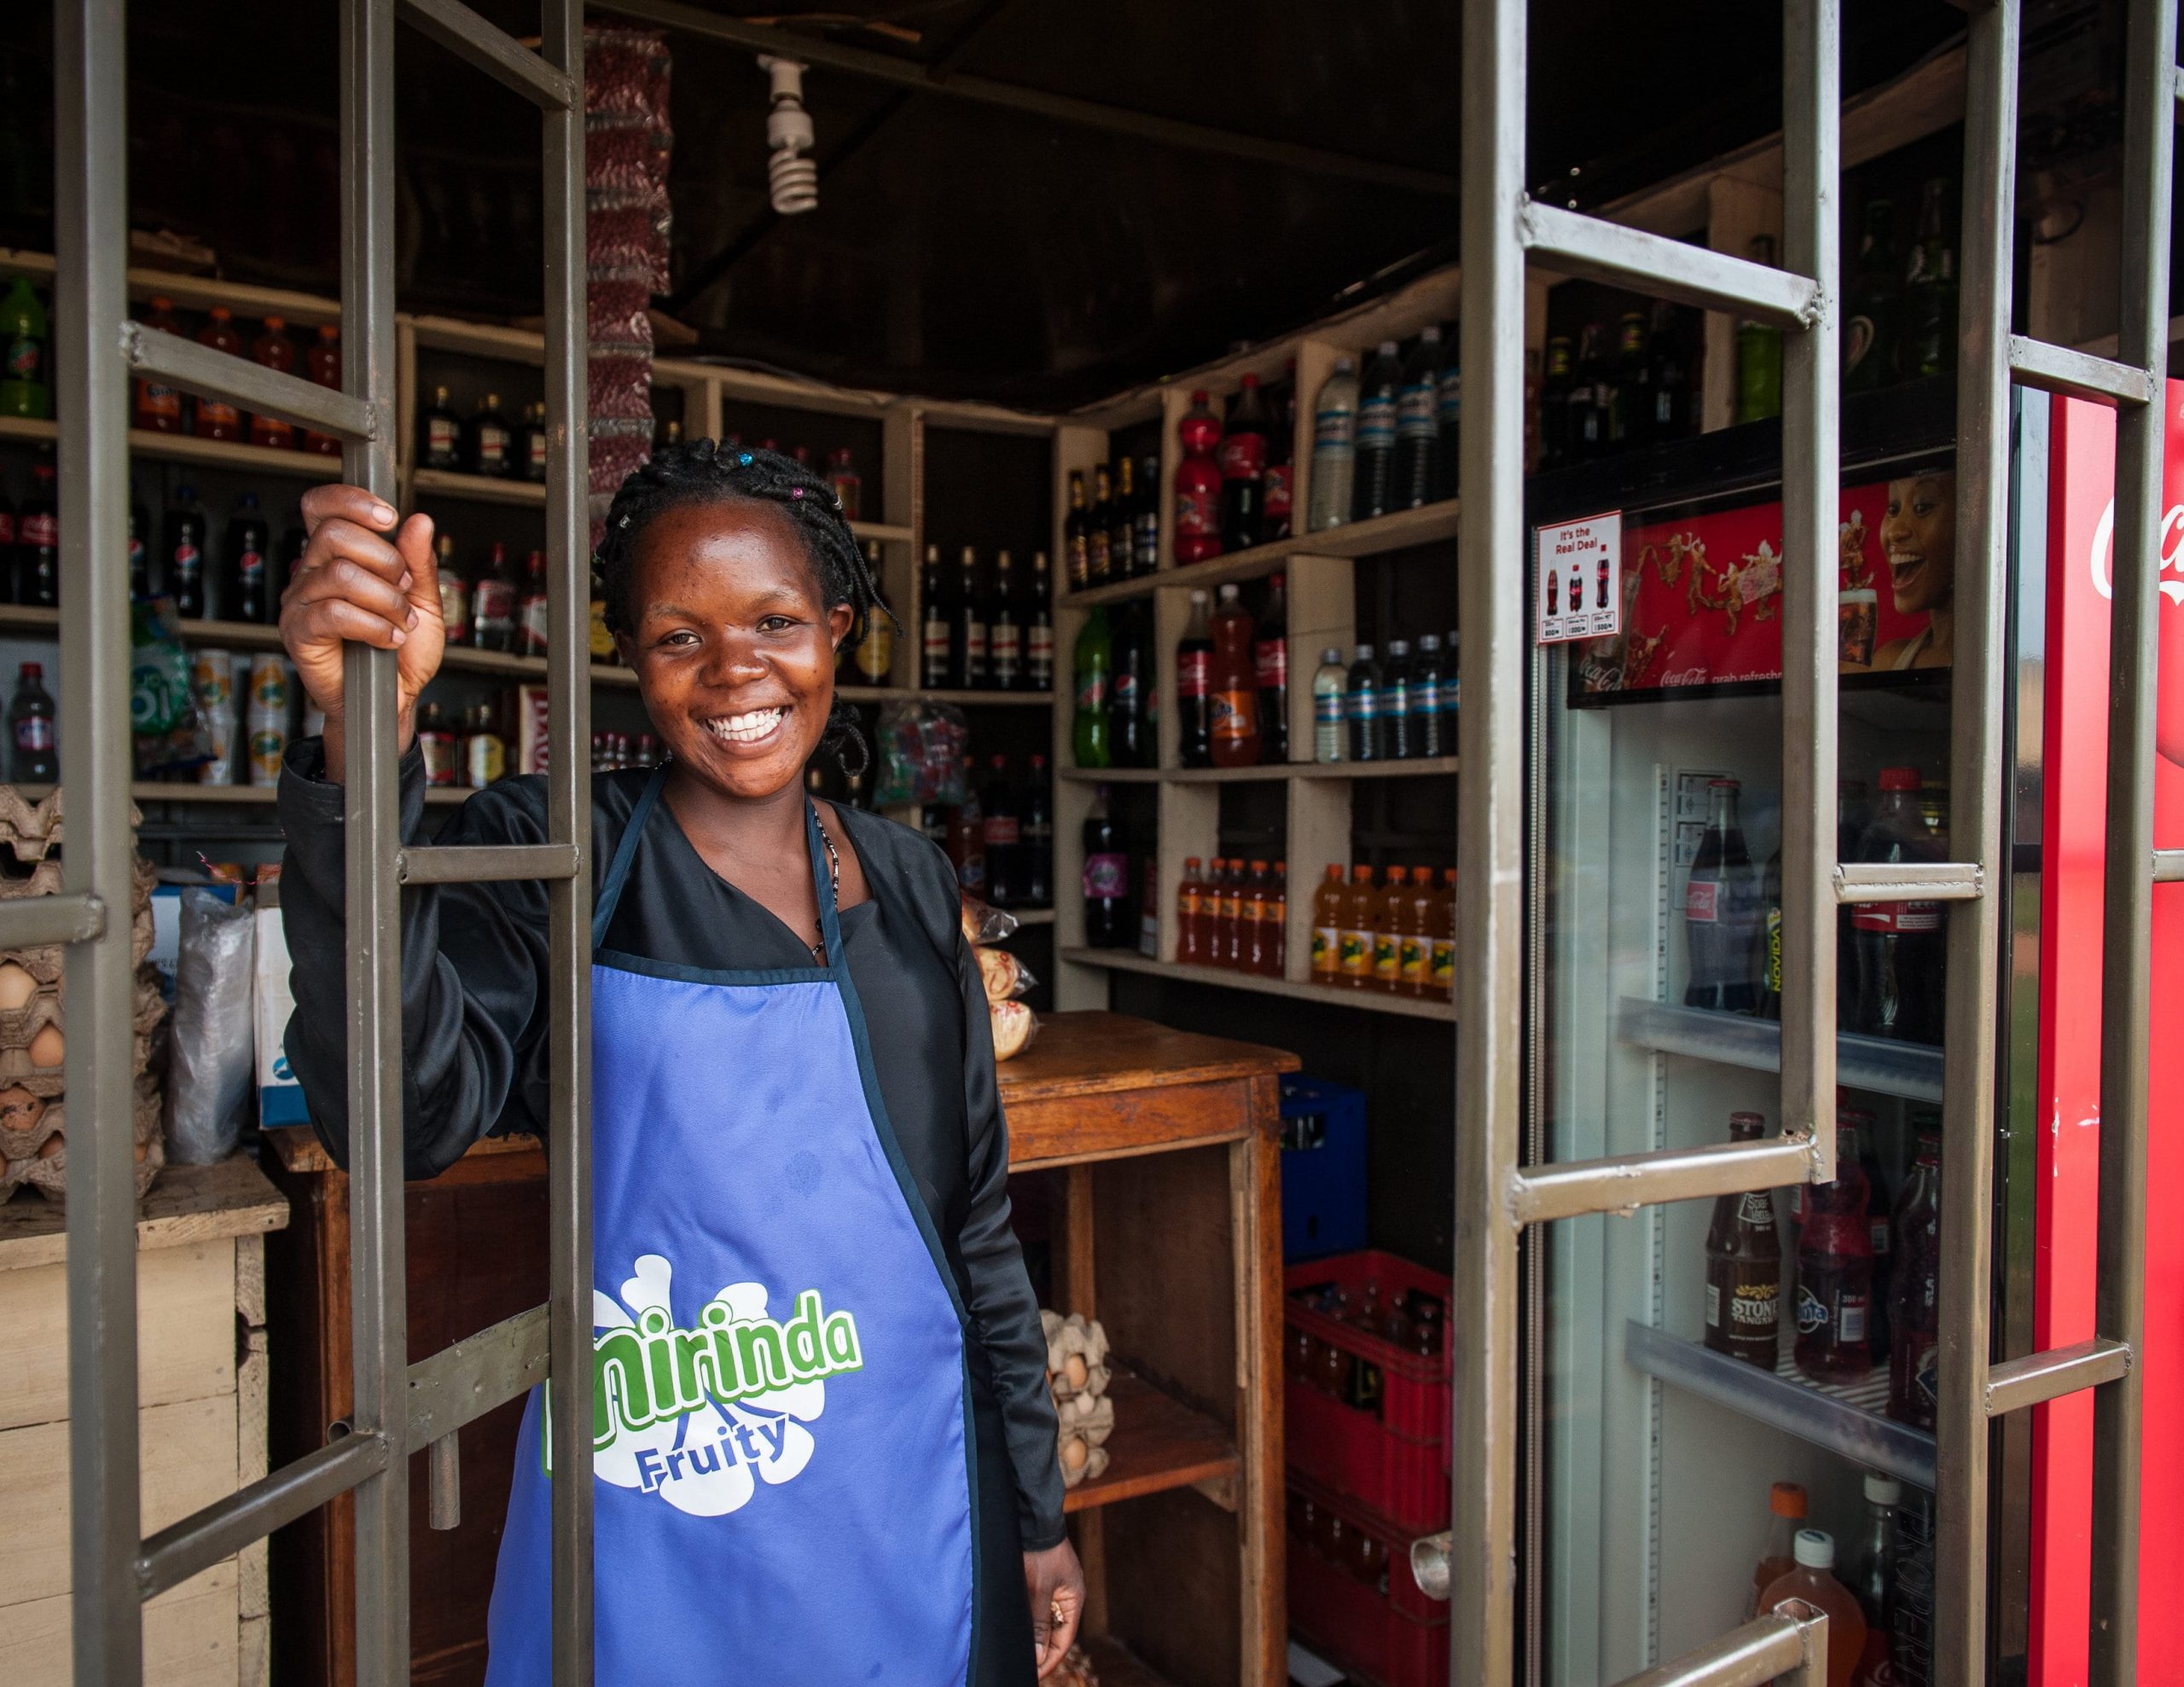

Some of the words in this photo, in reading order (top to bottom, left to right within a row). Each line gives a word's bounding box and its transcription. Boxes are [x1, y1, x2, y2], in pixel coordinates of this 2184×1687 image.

[1556, 543, 1574, 554] Real
[1577, 537, 1598, 551] Deal
[1560, 530, 1573, 541] It's
[1576, 527, 1590, 538] the
[1772, 928, 1781, 992] NOVIDA
[635, 1416, 787, 1491] Fruity
